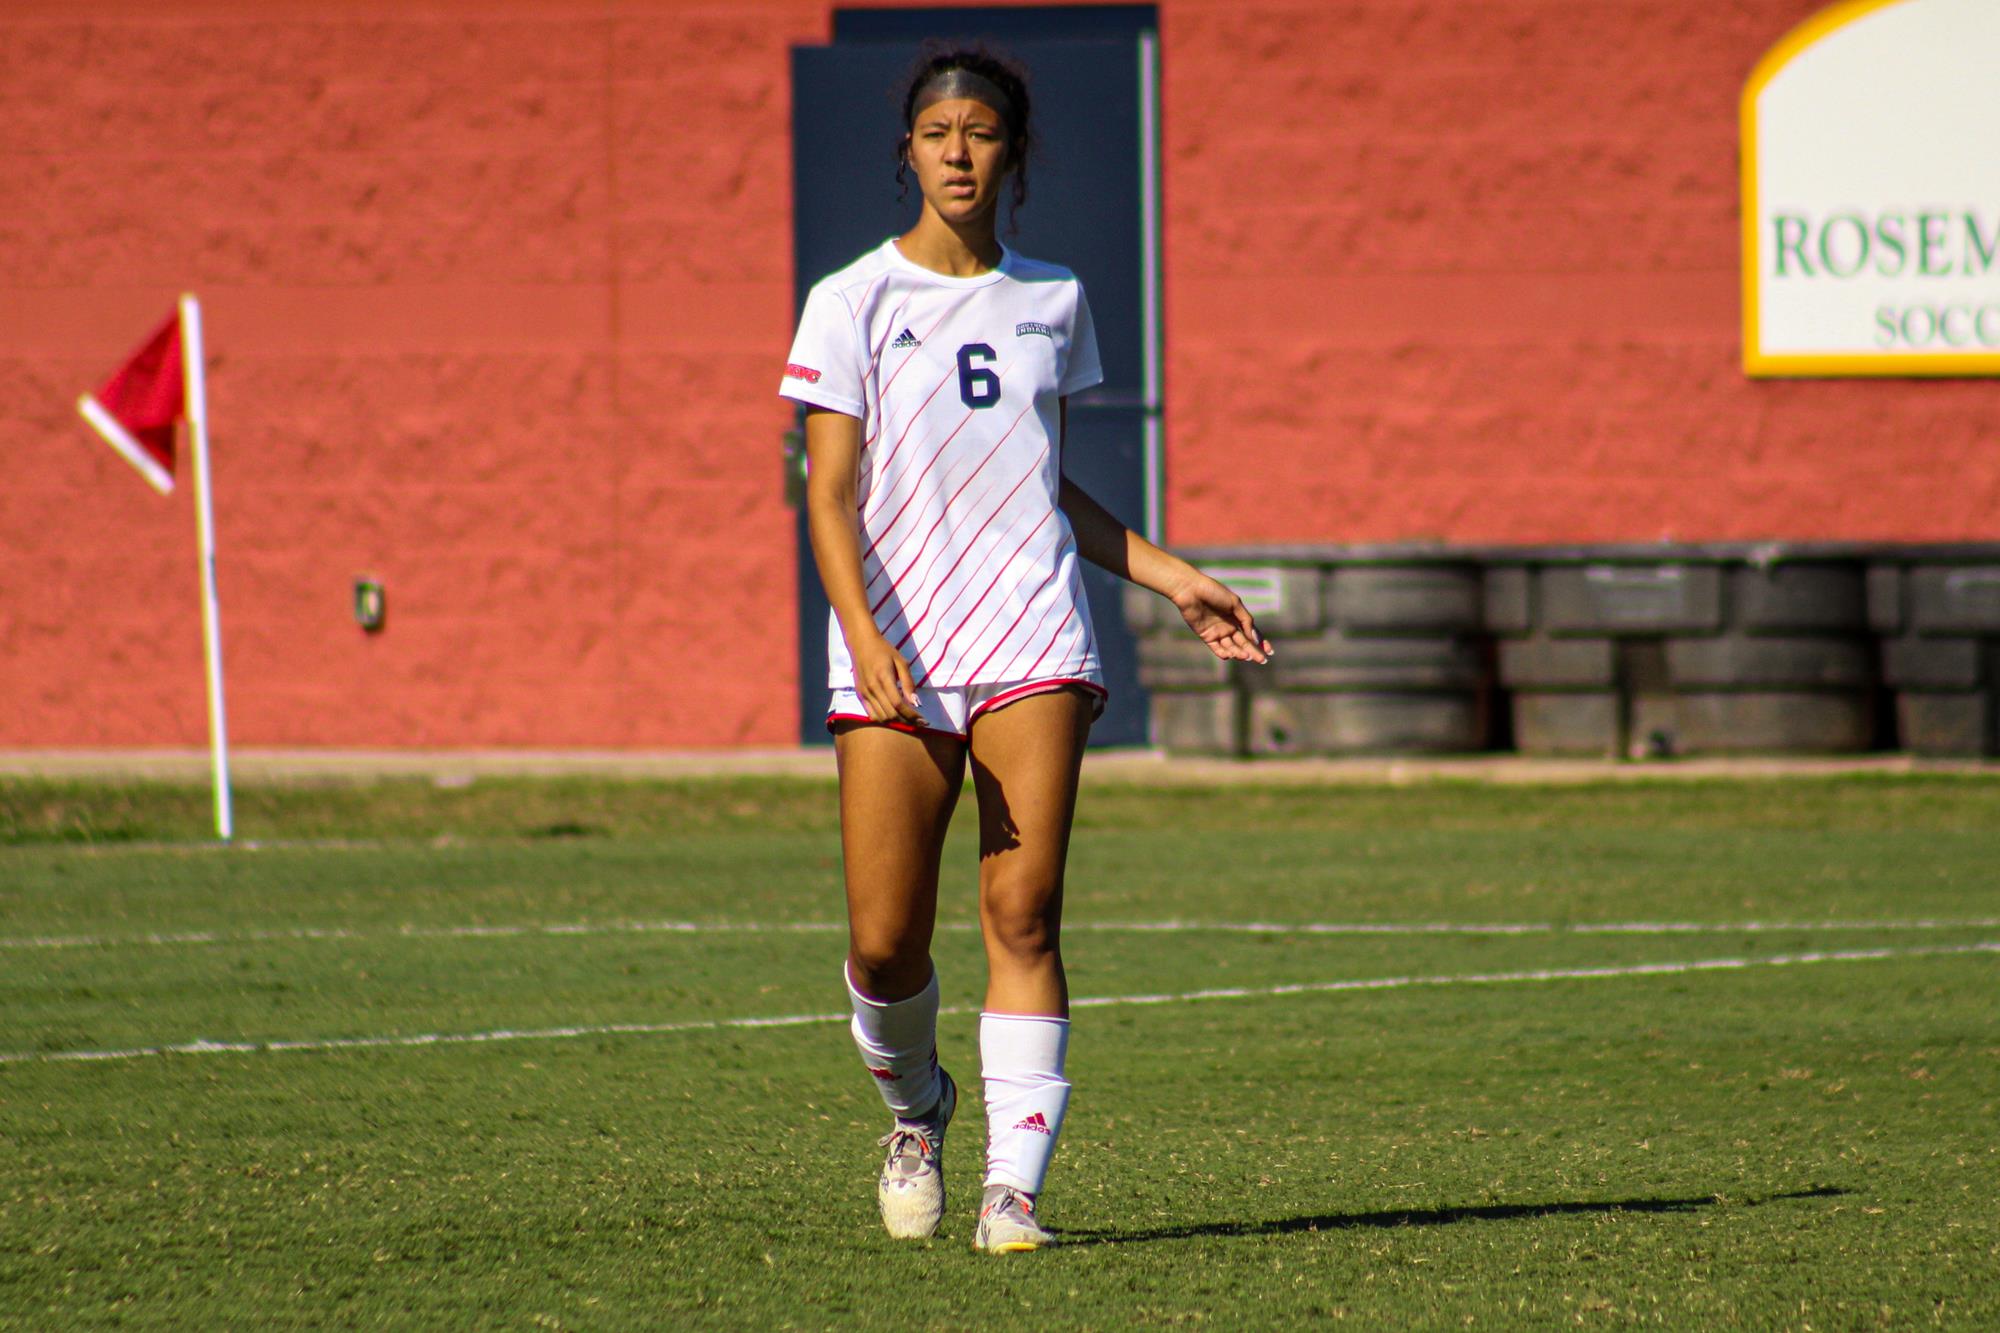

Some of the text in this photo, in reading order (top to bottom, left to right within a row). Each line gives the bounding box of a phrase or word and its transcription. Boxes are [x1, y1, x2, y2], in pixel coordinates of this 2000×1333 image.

[1773, 211, 2000, 277] ROSEM
[892, 340, 922, 349] adidas
[956, 343, 1001, 409] 6
